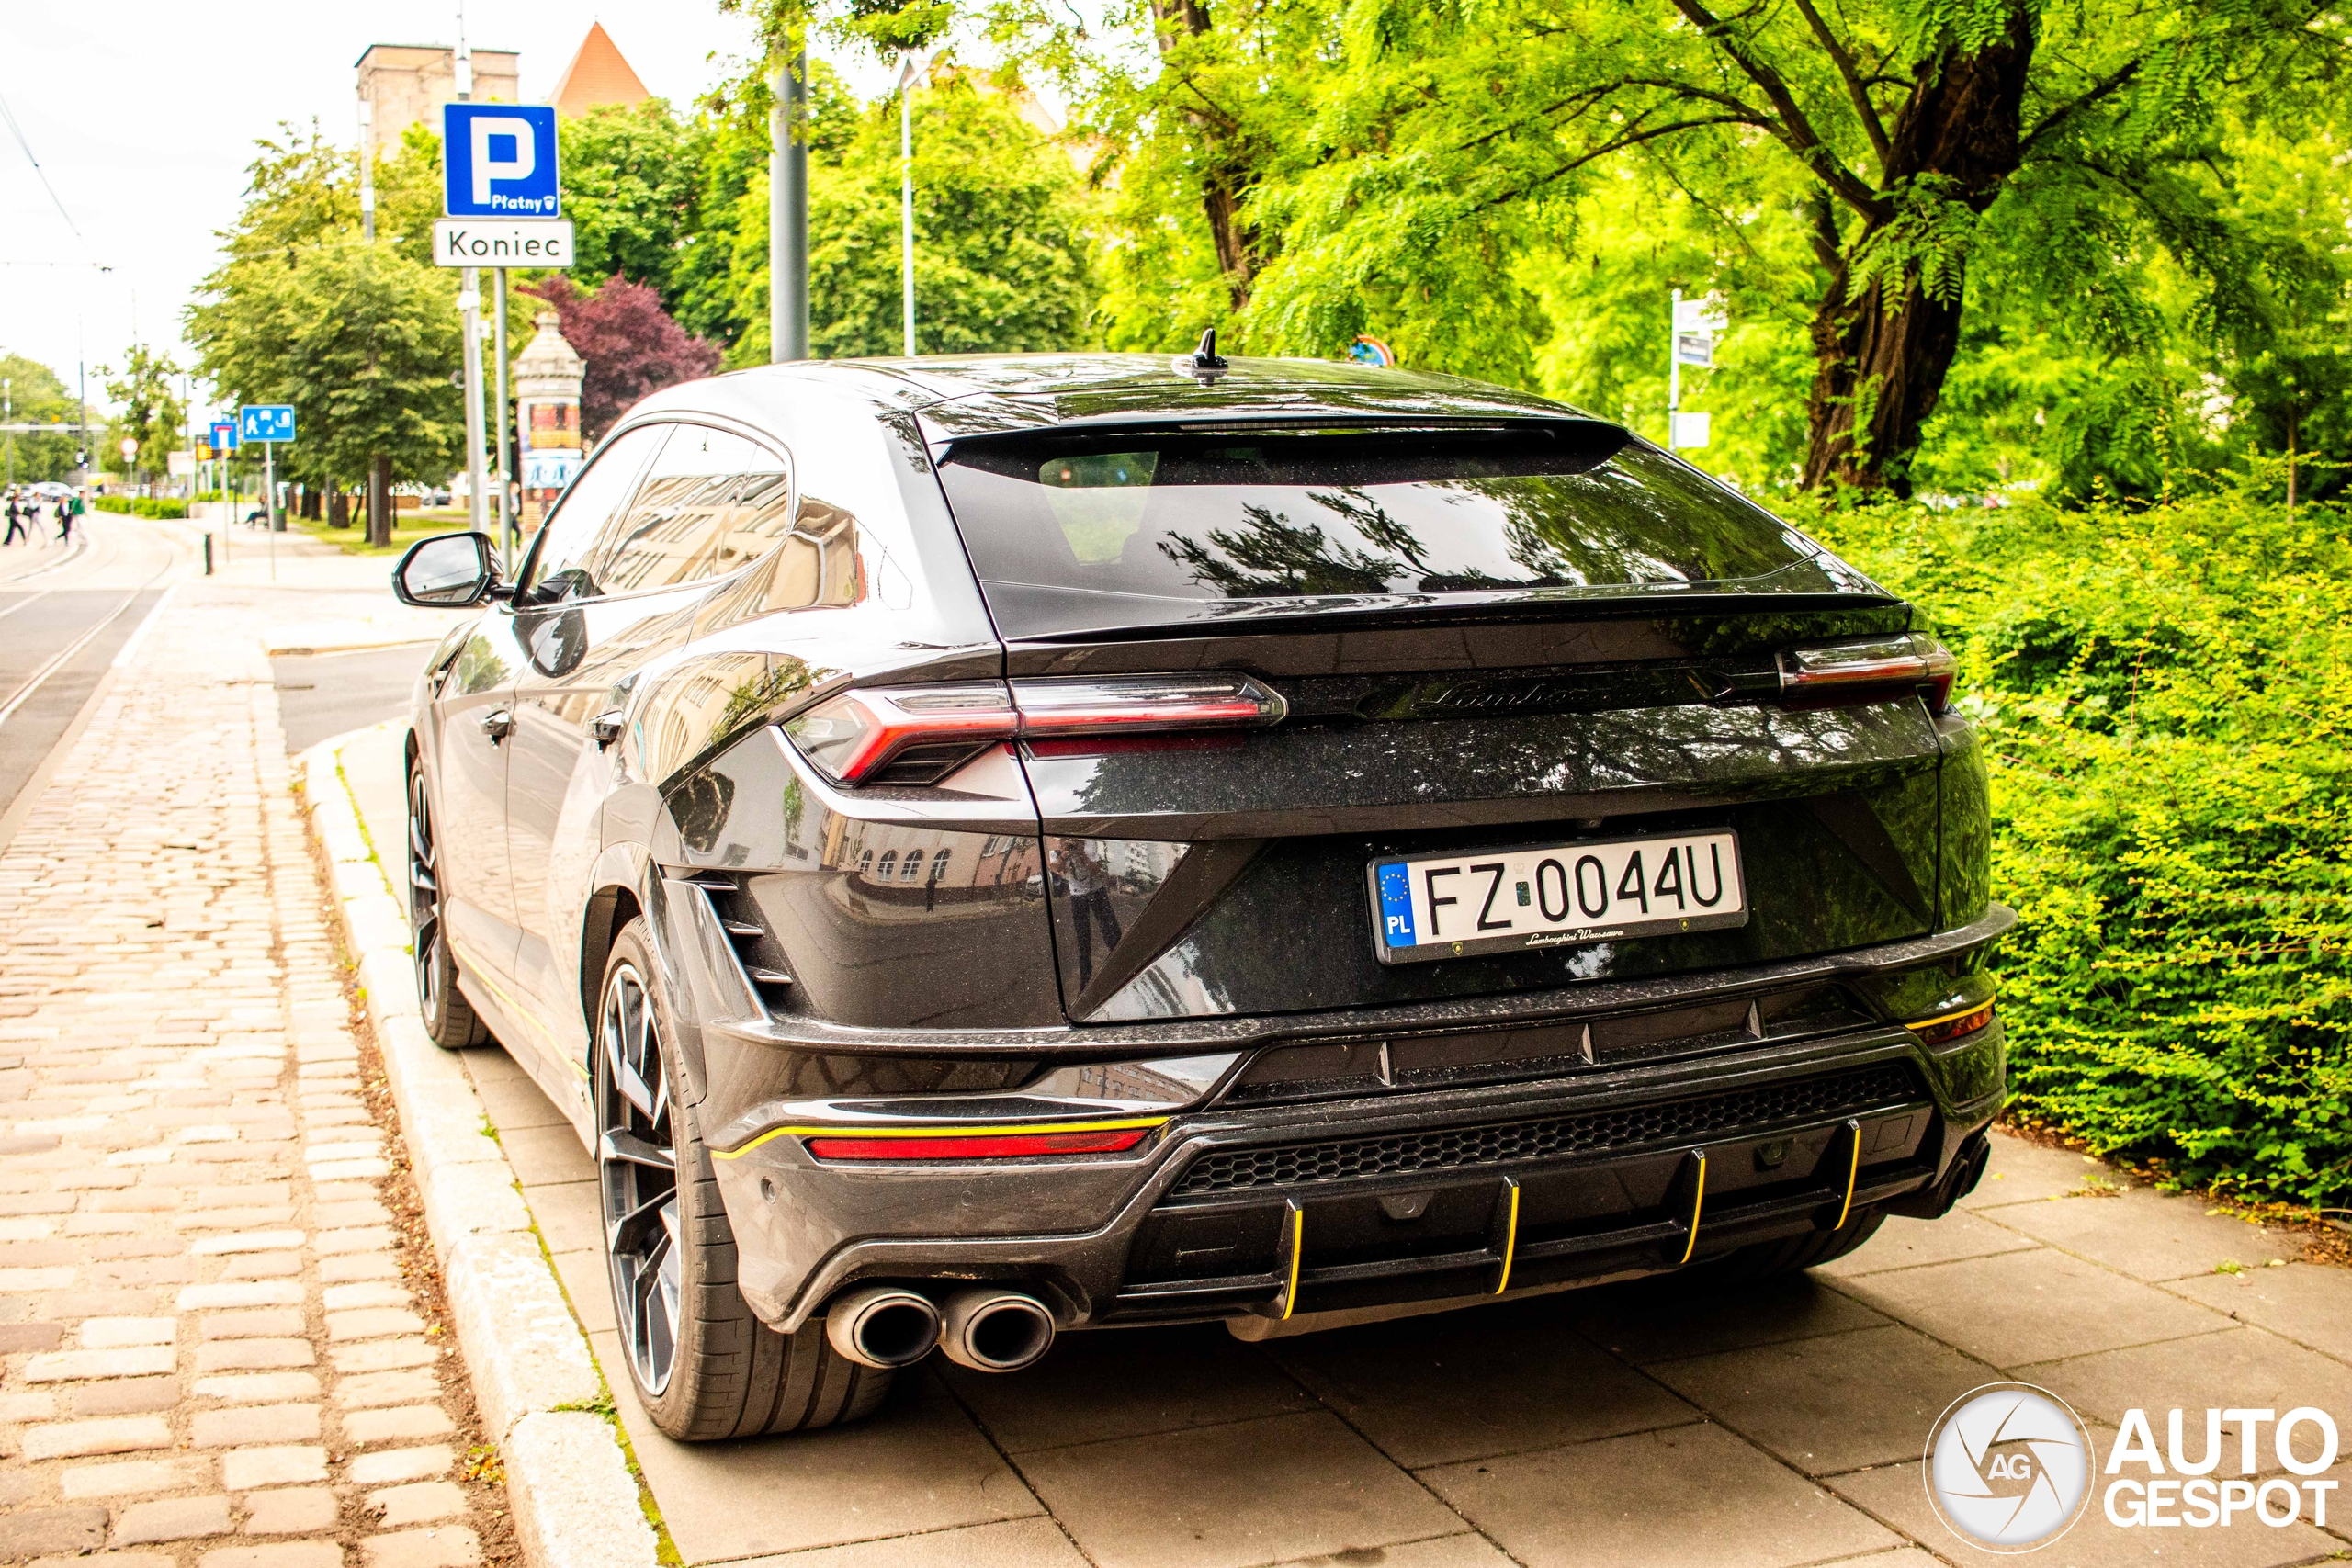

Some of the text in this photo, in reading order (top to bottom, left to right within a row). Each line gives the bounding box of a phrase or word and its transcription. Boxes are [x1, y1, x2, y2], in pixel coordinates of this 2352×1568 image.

[470, 116, 536, 204] P
[492, 194, 543, 213] Płatny
[449, 231, 560, 256] Koniec
[1386, 915, 1411, 935] PL
[1526, 932, 1577, 946] Lamborghini
